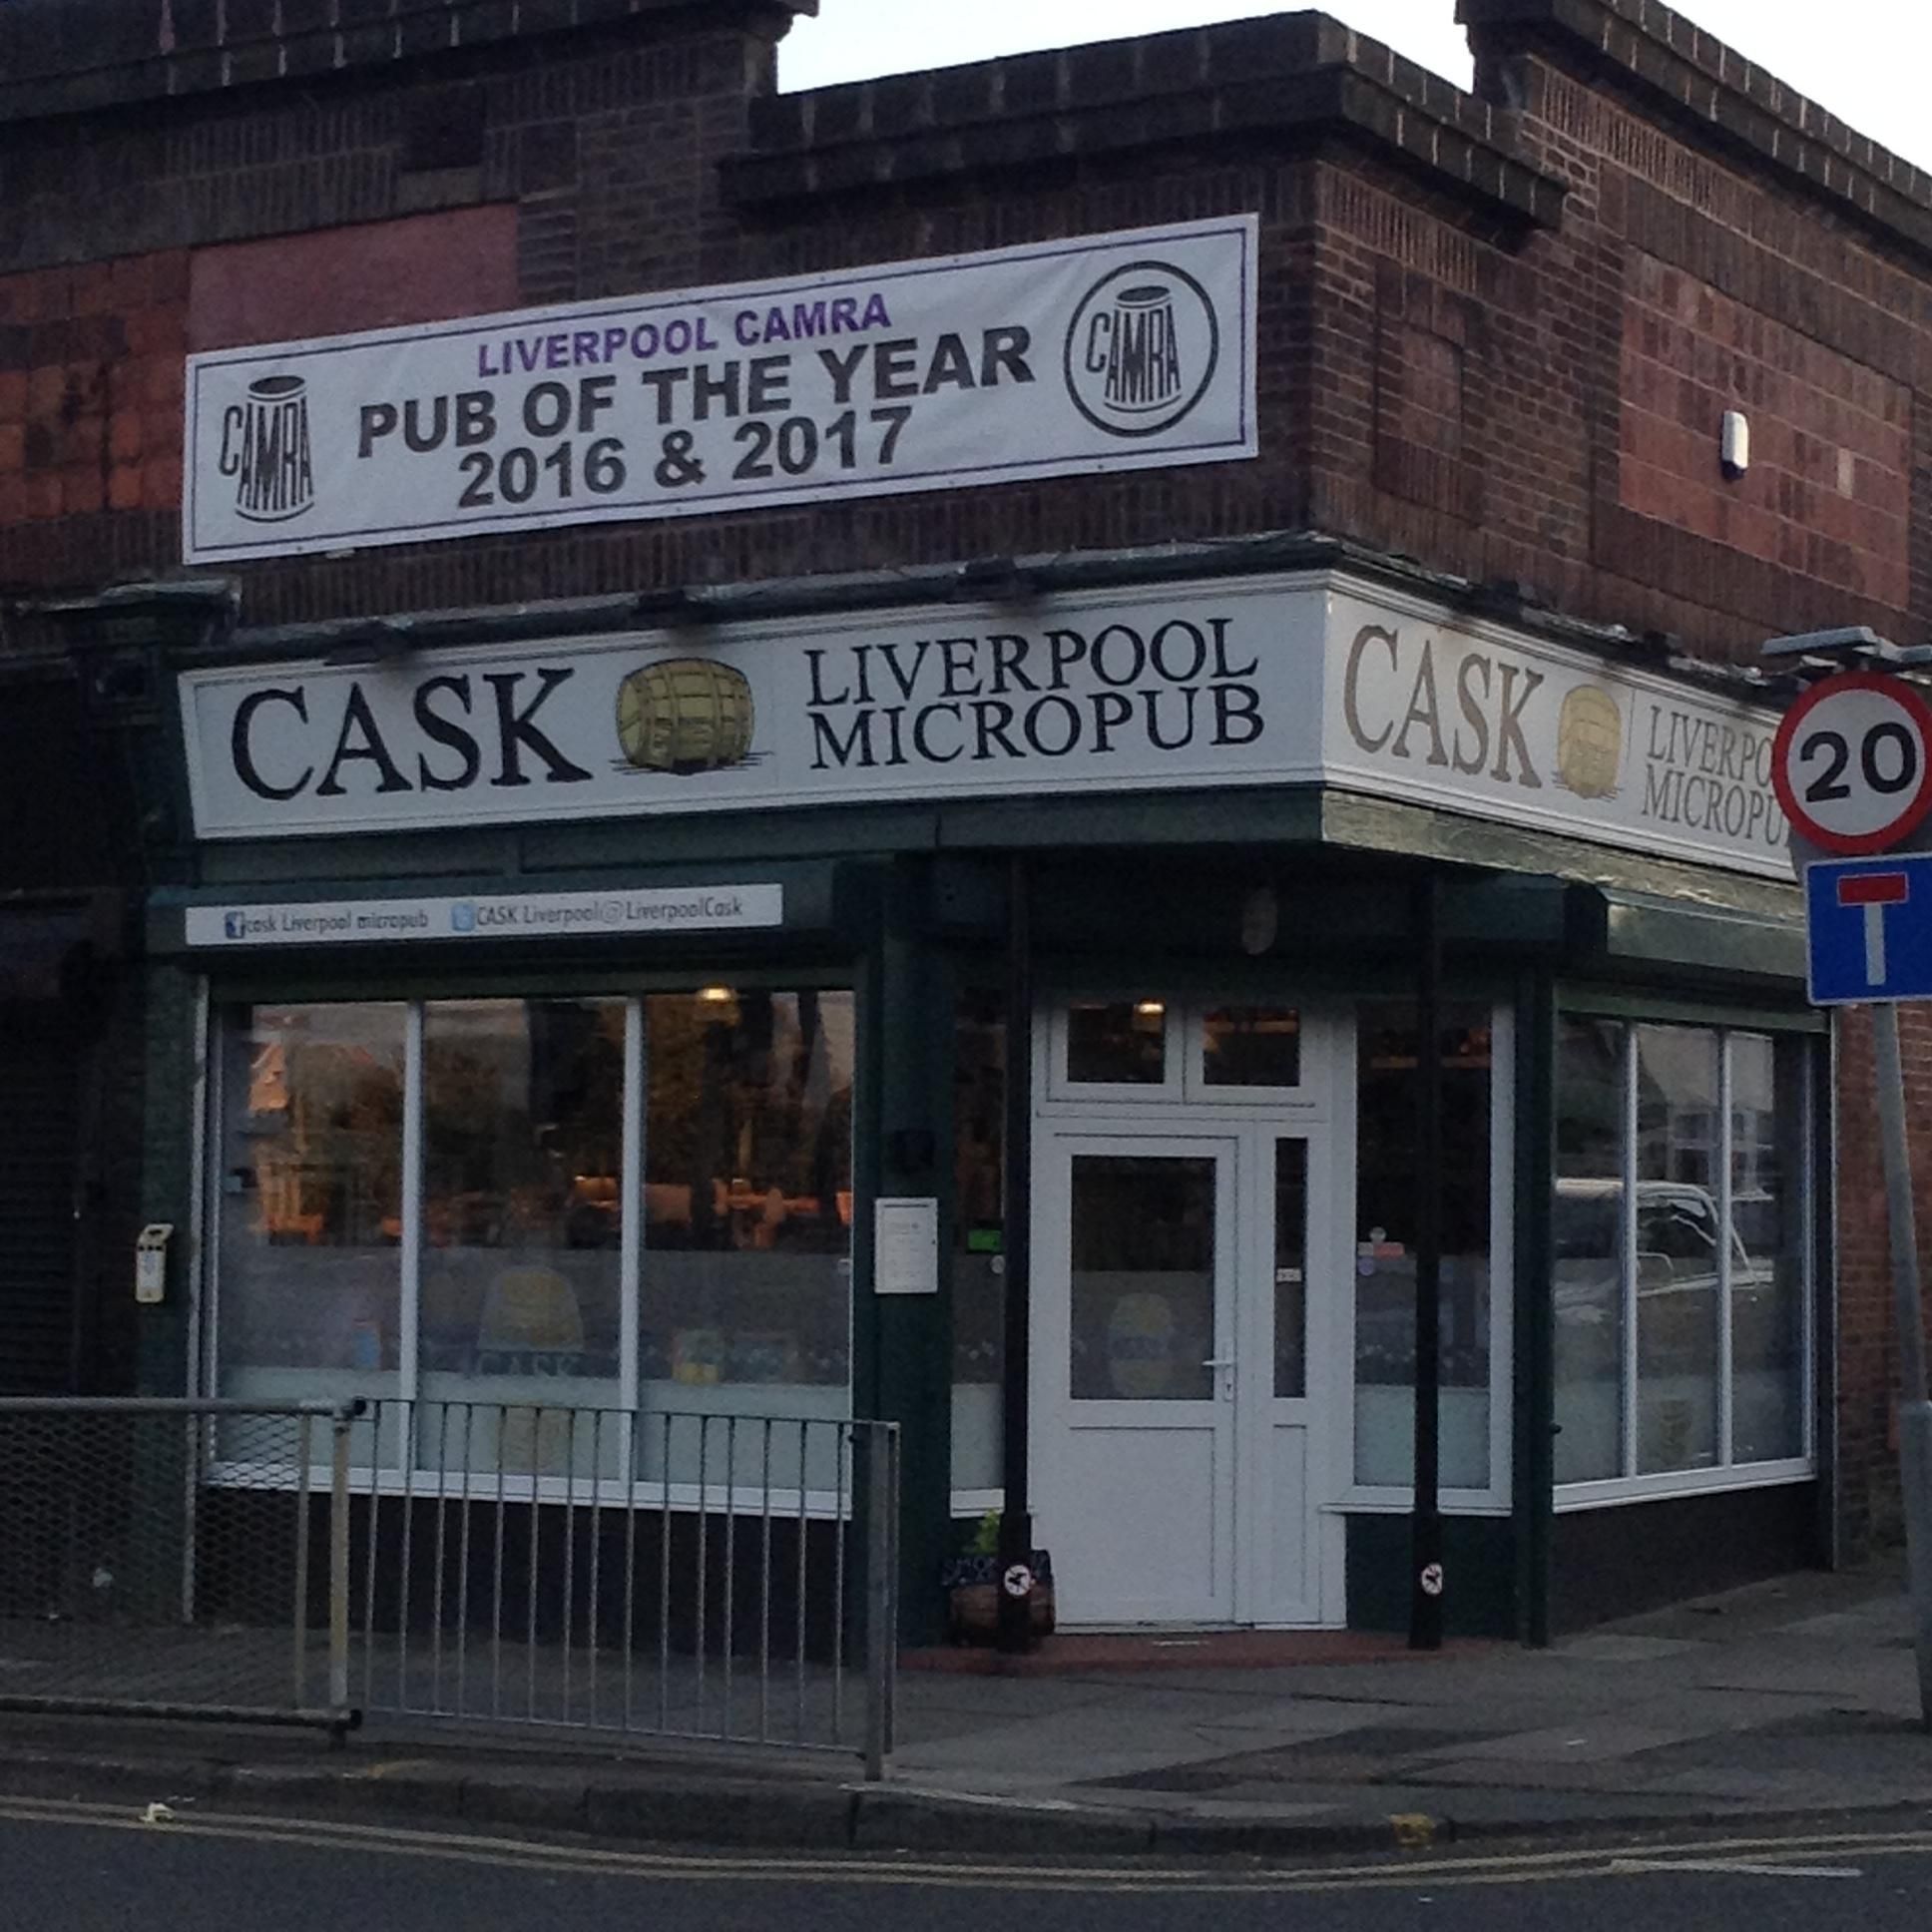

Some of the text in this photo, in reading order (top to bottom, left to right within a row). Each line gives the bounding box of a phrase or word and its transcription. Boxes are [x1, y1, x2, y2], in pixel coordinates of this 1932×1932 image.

[478, 292, 893, 378] LIVERPOOL CAMRA
[1085, 304, 1182, 404] CAMRA
[357, 324, 1036, 459] PUB OF THE YEAR
[218, 397, 315, 513] CAMRA
[457, 405, 913, 508] 2016 & 2017
[803, 618, 1259, 707] LIVERPOOL
[1343, 624, 1545, 789] CASK
[231, 667, 595, 800] CASK
[805, 683, 1265, 769] MICROPUB
[1647, 705, 1773, 787] LIVERPO
[1799, 721, 1917, 803] 20
[1641, 762, 1783, 845] MICROPU
